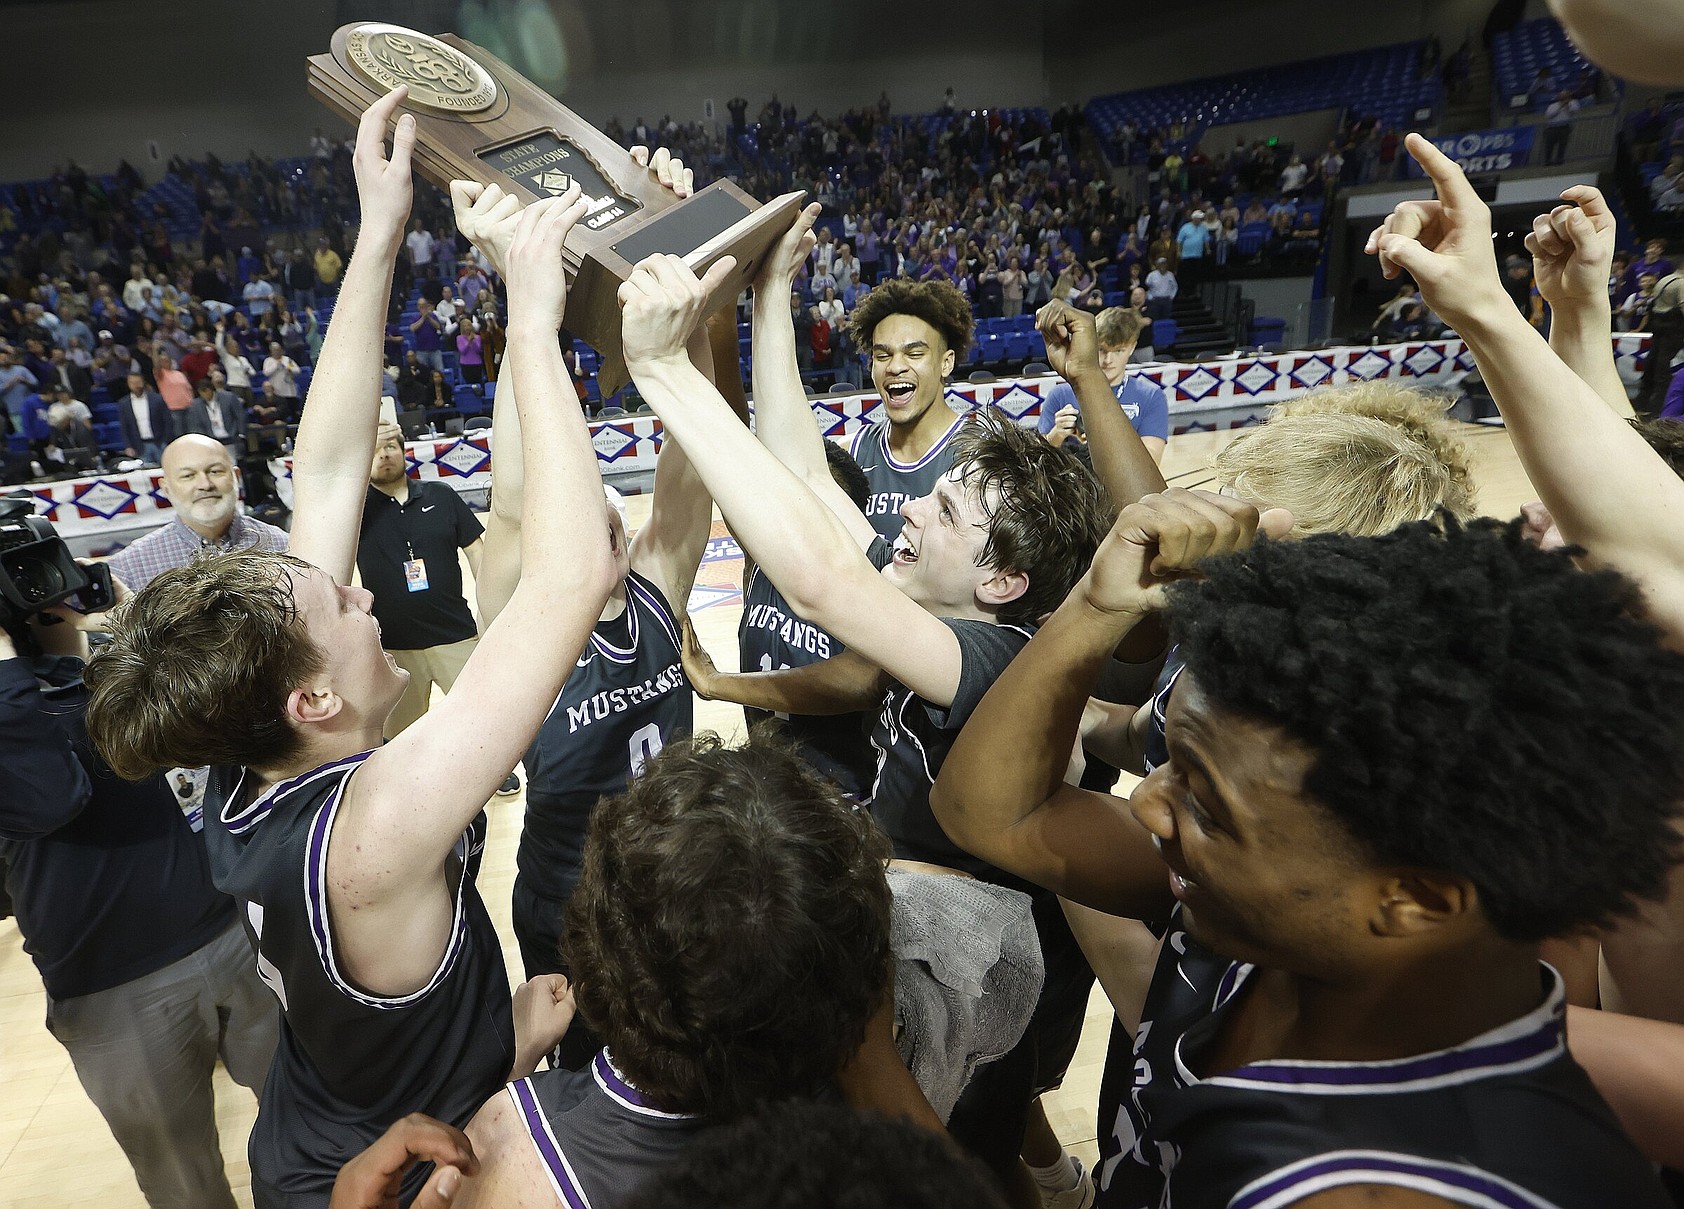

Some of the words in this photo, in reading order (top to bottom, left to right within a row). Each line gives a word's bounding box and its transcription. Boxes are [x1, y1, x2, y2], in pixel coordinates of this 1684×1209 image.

[437, 95, 486, 107] FOUNDED
[500, 143, 540, 163] STATE
[502, 148, 571, 178] CHAMPIONS
[1457, 152, 1513, 174] ORTS
[594, 437, 628, 447] ENTENNIAL
[443, 453, 482, 462] CENTENNIAL
[745, 603, 831, 660] MUSTANGS
[566, 662, 684, 735] MUSTANGS
